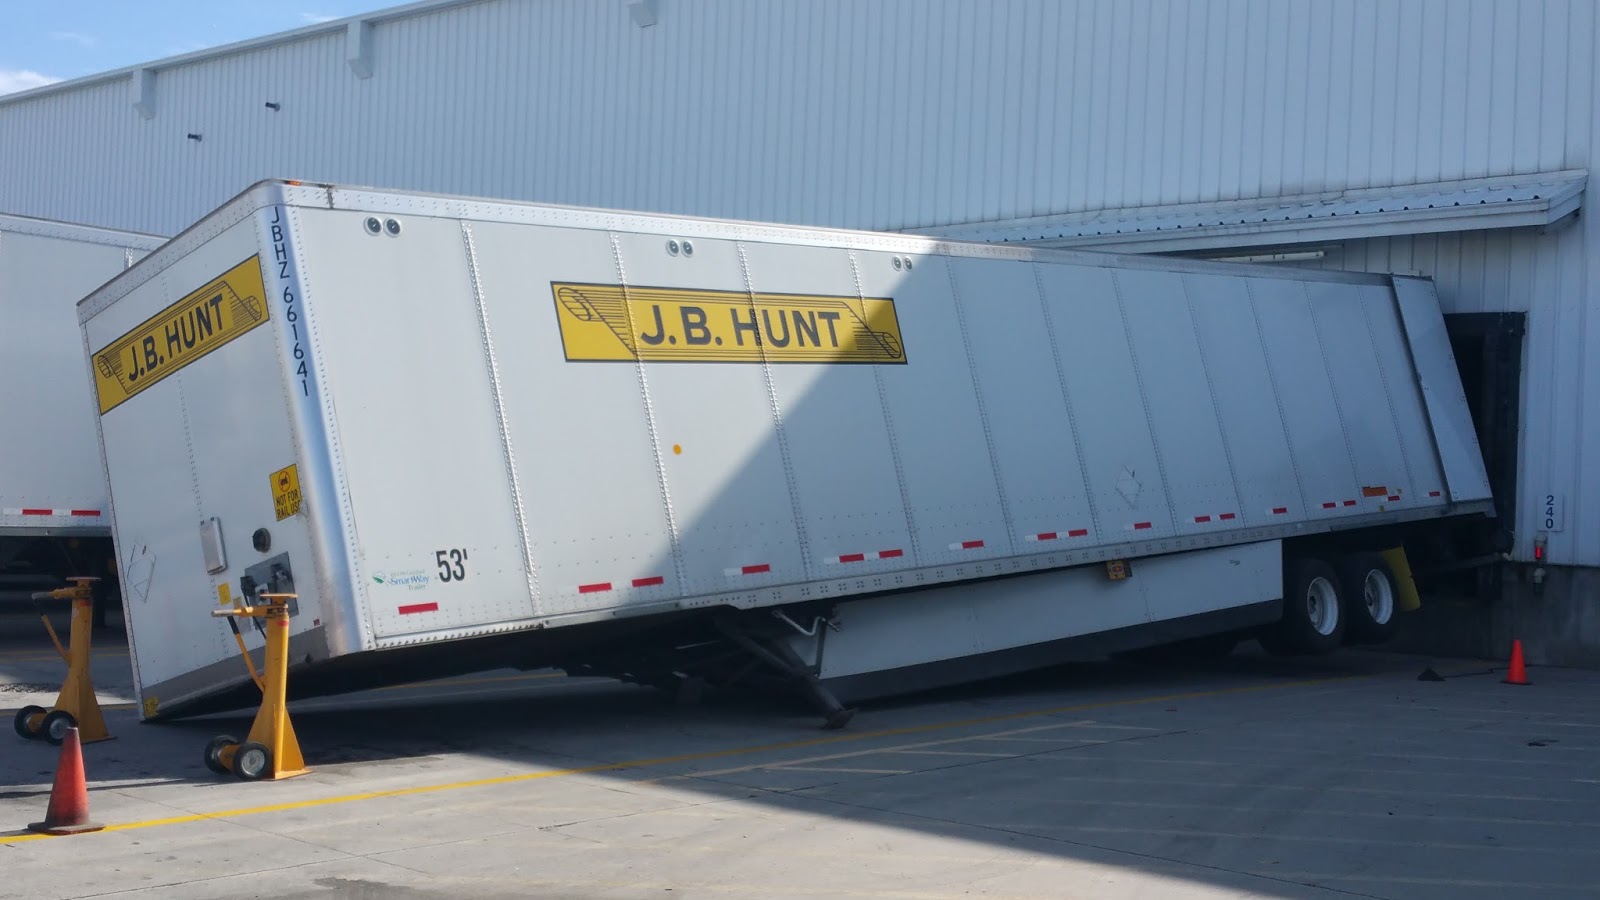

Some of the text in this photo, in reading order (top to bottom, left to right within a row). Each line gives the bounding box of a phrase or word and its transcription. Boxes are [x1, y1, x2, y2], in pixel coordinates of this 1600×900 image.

[271, 206, 308, 396] JBHZ 661641
[128, 293, 223, 382] J.B. HUNT
[640, 304, 841, 348] J.B. HUNT
[276, 489, 299, 508] NOT FOR
[276, 505, 290, 520] RAIL
[1545, 494, 1555, 529] 240
[390, 574, 430, 585] SmartWay
